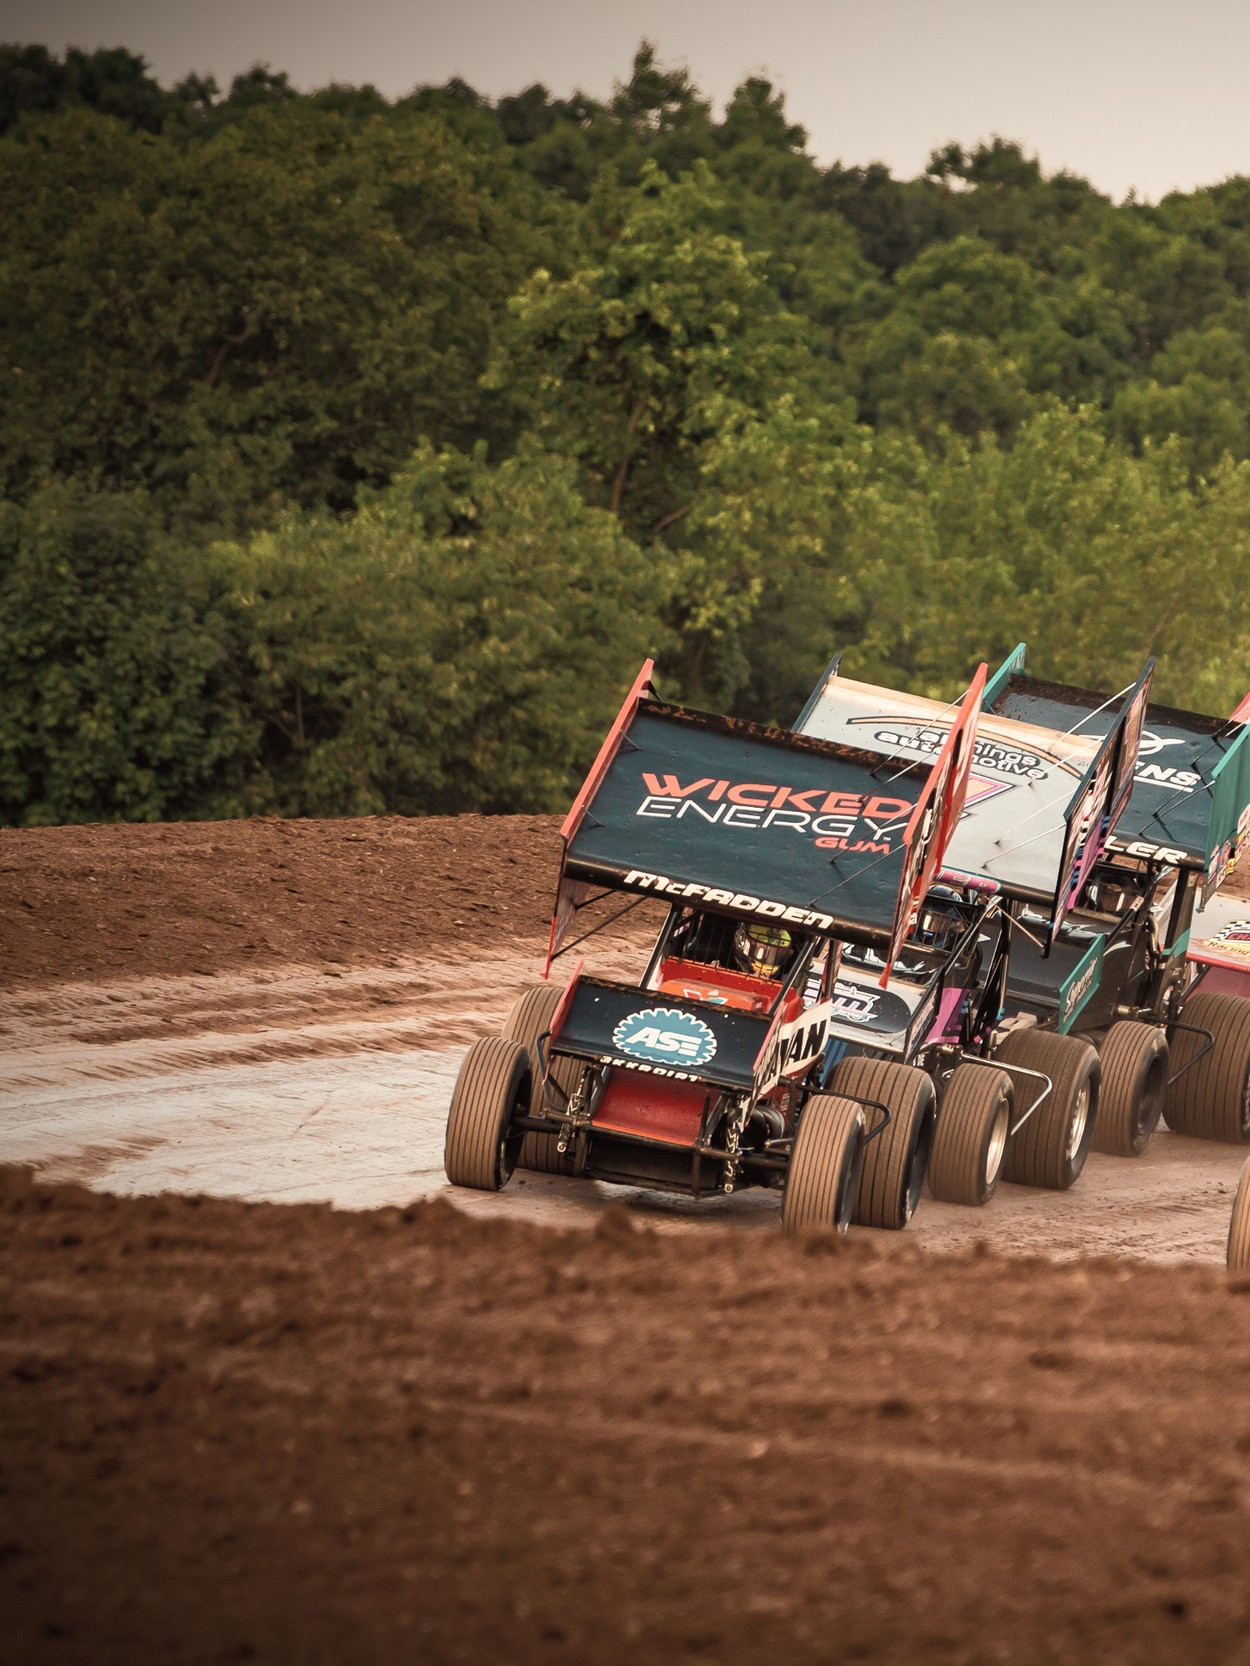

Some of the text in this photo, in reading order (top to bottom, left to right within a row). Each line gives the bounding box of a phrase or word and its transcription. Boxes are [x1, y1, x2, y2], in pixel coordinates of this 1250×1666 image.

[641, 772, 913, 820] WICKED
[636, 796, 909, 841] ENERGY
[814, 836, 890, 855] GUM
[1104, 835, 1188, 865] LER
[625, 1027, 703, 1057] ASE
